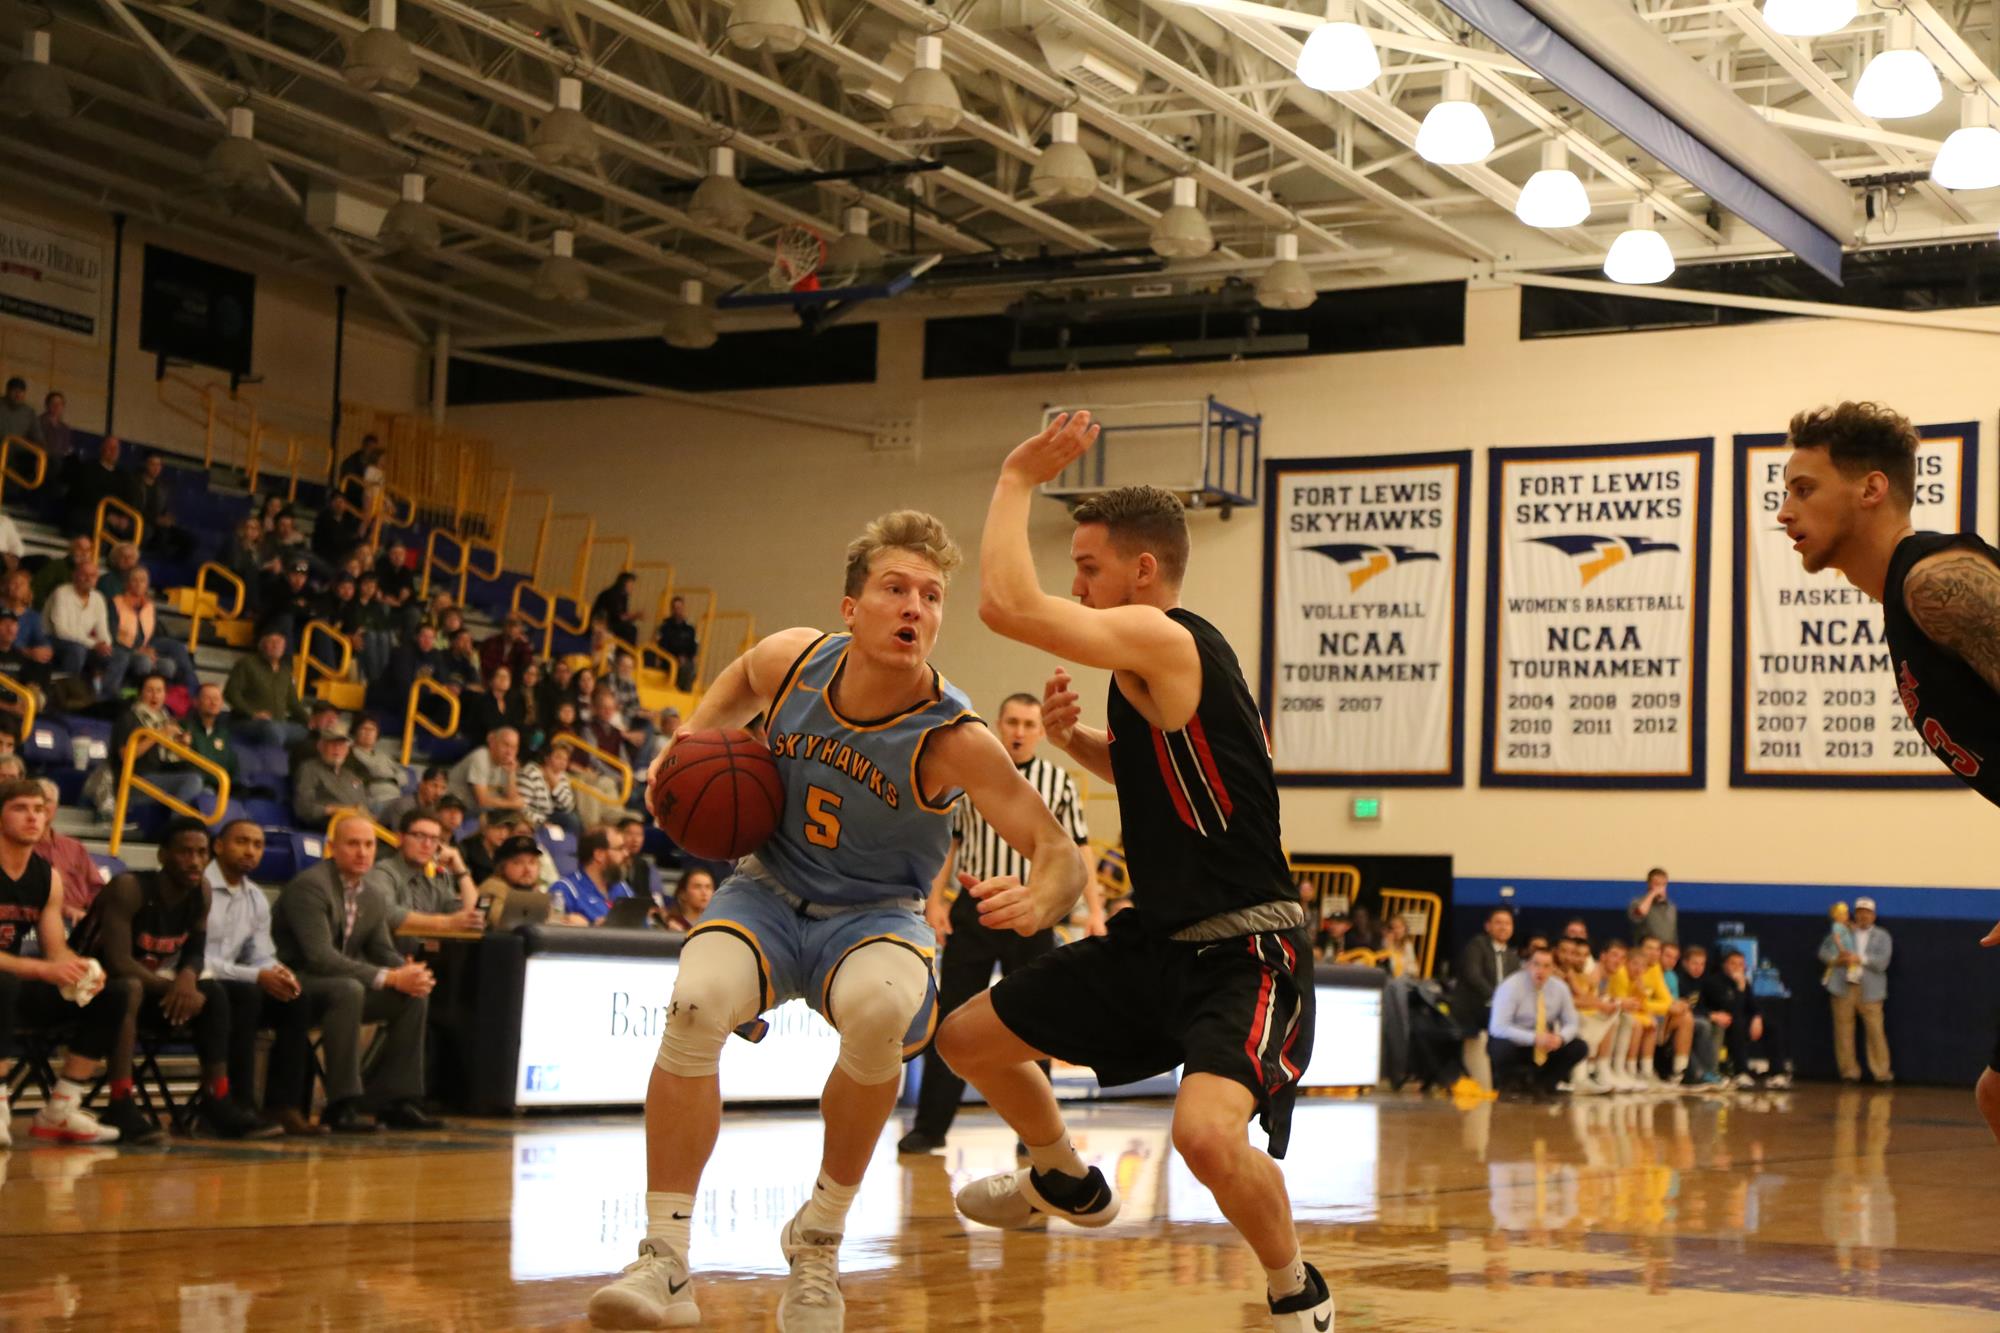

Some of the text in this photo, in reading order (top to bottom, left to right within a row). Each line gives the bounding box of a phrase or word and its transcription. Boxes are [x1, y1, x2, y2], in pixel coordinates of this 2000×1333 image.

[1520, 471, 1680, 496] FORT LEWIS
[1293, 482, 1441, 506] FORT LEWIS
[1290, 508, 1442, 532] SKYHAWKS
[1517, 498, 1681, 524] SKYHAWKS
[1508, 595, 1684, 613] WOMEN'S BASKETBALL
[1779, 589, 1877, 605] BASKET
[1301, 602, 1426, 621] VOLLEYBALL
[1320, 632, 1405, 656] NCAA
[1548, 626, 1641, 651] NCAA
[1283, 662, 1440, 682] TOURNAMENT
[1509, 658, 1680, 678] TOURNAMENT
[1760, 653, 1889, 673] TOURNAM
[1336, 696, 1383, 712] 2007
[1508, 693, 1681, 710] 2004 2008 2009
[1757, 689, 1807, 706] 2002
[1823, 690, 1876, 706] 2003
[1508, 717, 1677, 736] 2010 2011 2012
[1757, 714, 1807, 732] 2007
[1823, 716, 1875, 732] 2008
[1507, 741, 1552, 760] 2013
[1760, 741, 1934, 758] 2011 2013 201
[775, 732, 899, 810] SKYHAWKS
[803, 783, 843, 850] 5
